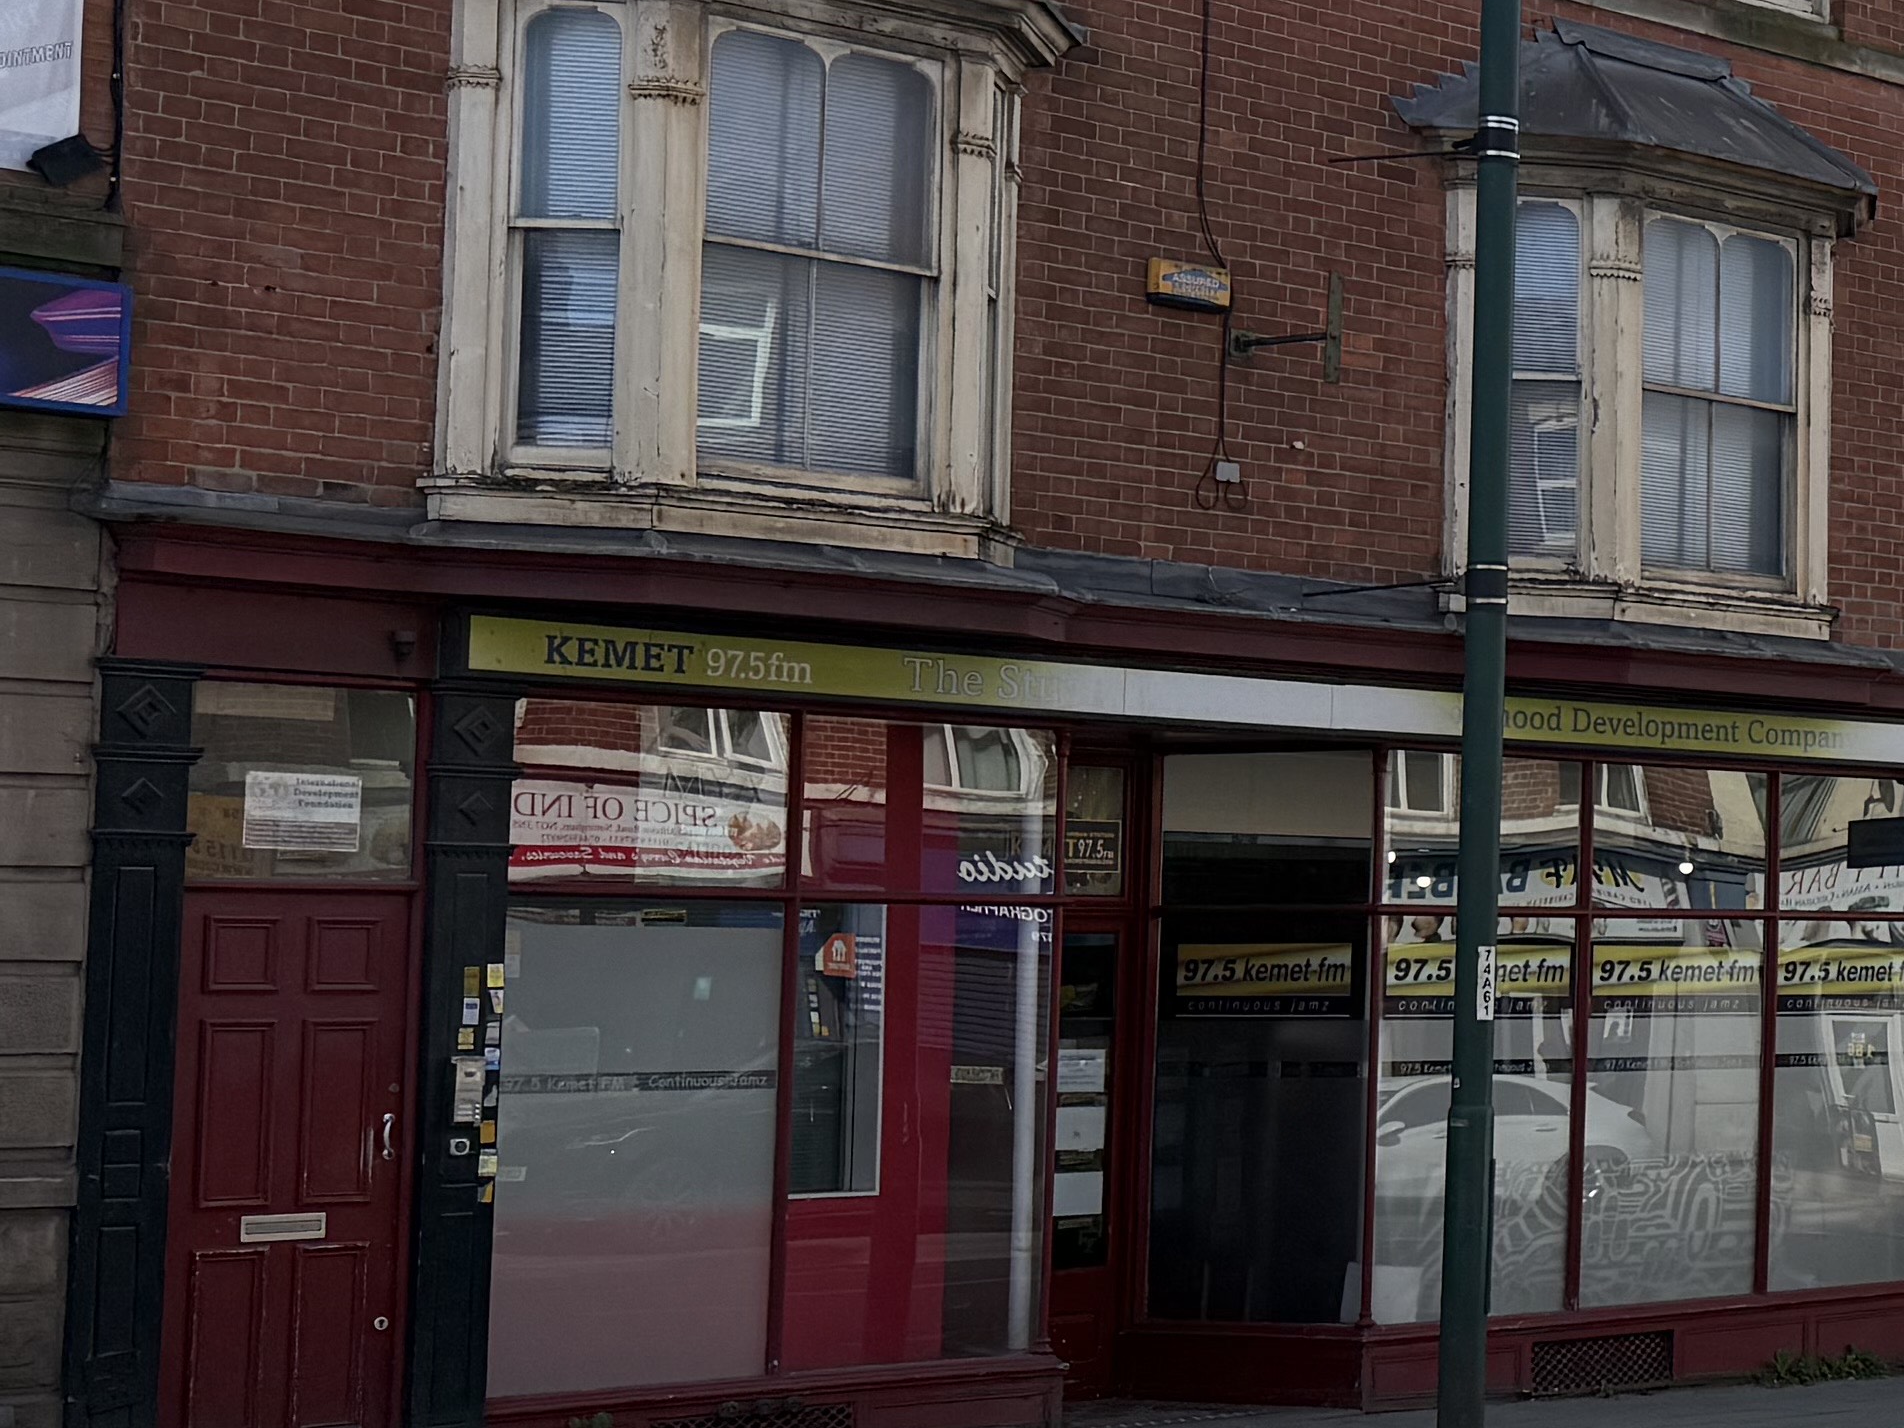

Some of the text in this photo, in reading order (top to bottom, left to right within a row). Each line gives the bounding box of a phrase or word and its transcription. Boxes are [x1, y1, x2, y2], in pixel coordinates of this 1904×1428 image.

[545, 634, 812, 684] KEMET 97.5fm
[903, 657, 983, 697] The
[1571, 706, 1740, 753] Development
[1183, 958, 1237, 983] 97.5
[1394, 958, 1452, 982] 97.5
[1599, 959, 1654, 982] 97.5
[1783, 960, 1831, 982] 97.5
[1187, 999, 1282, 1011] continuous
[1603, 997, 1695, 1010] continuous
